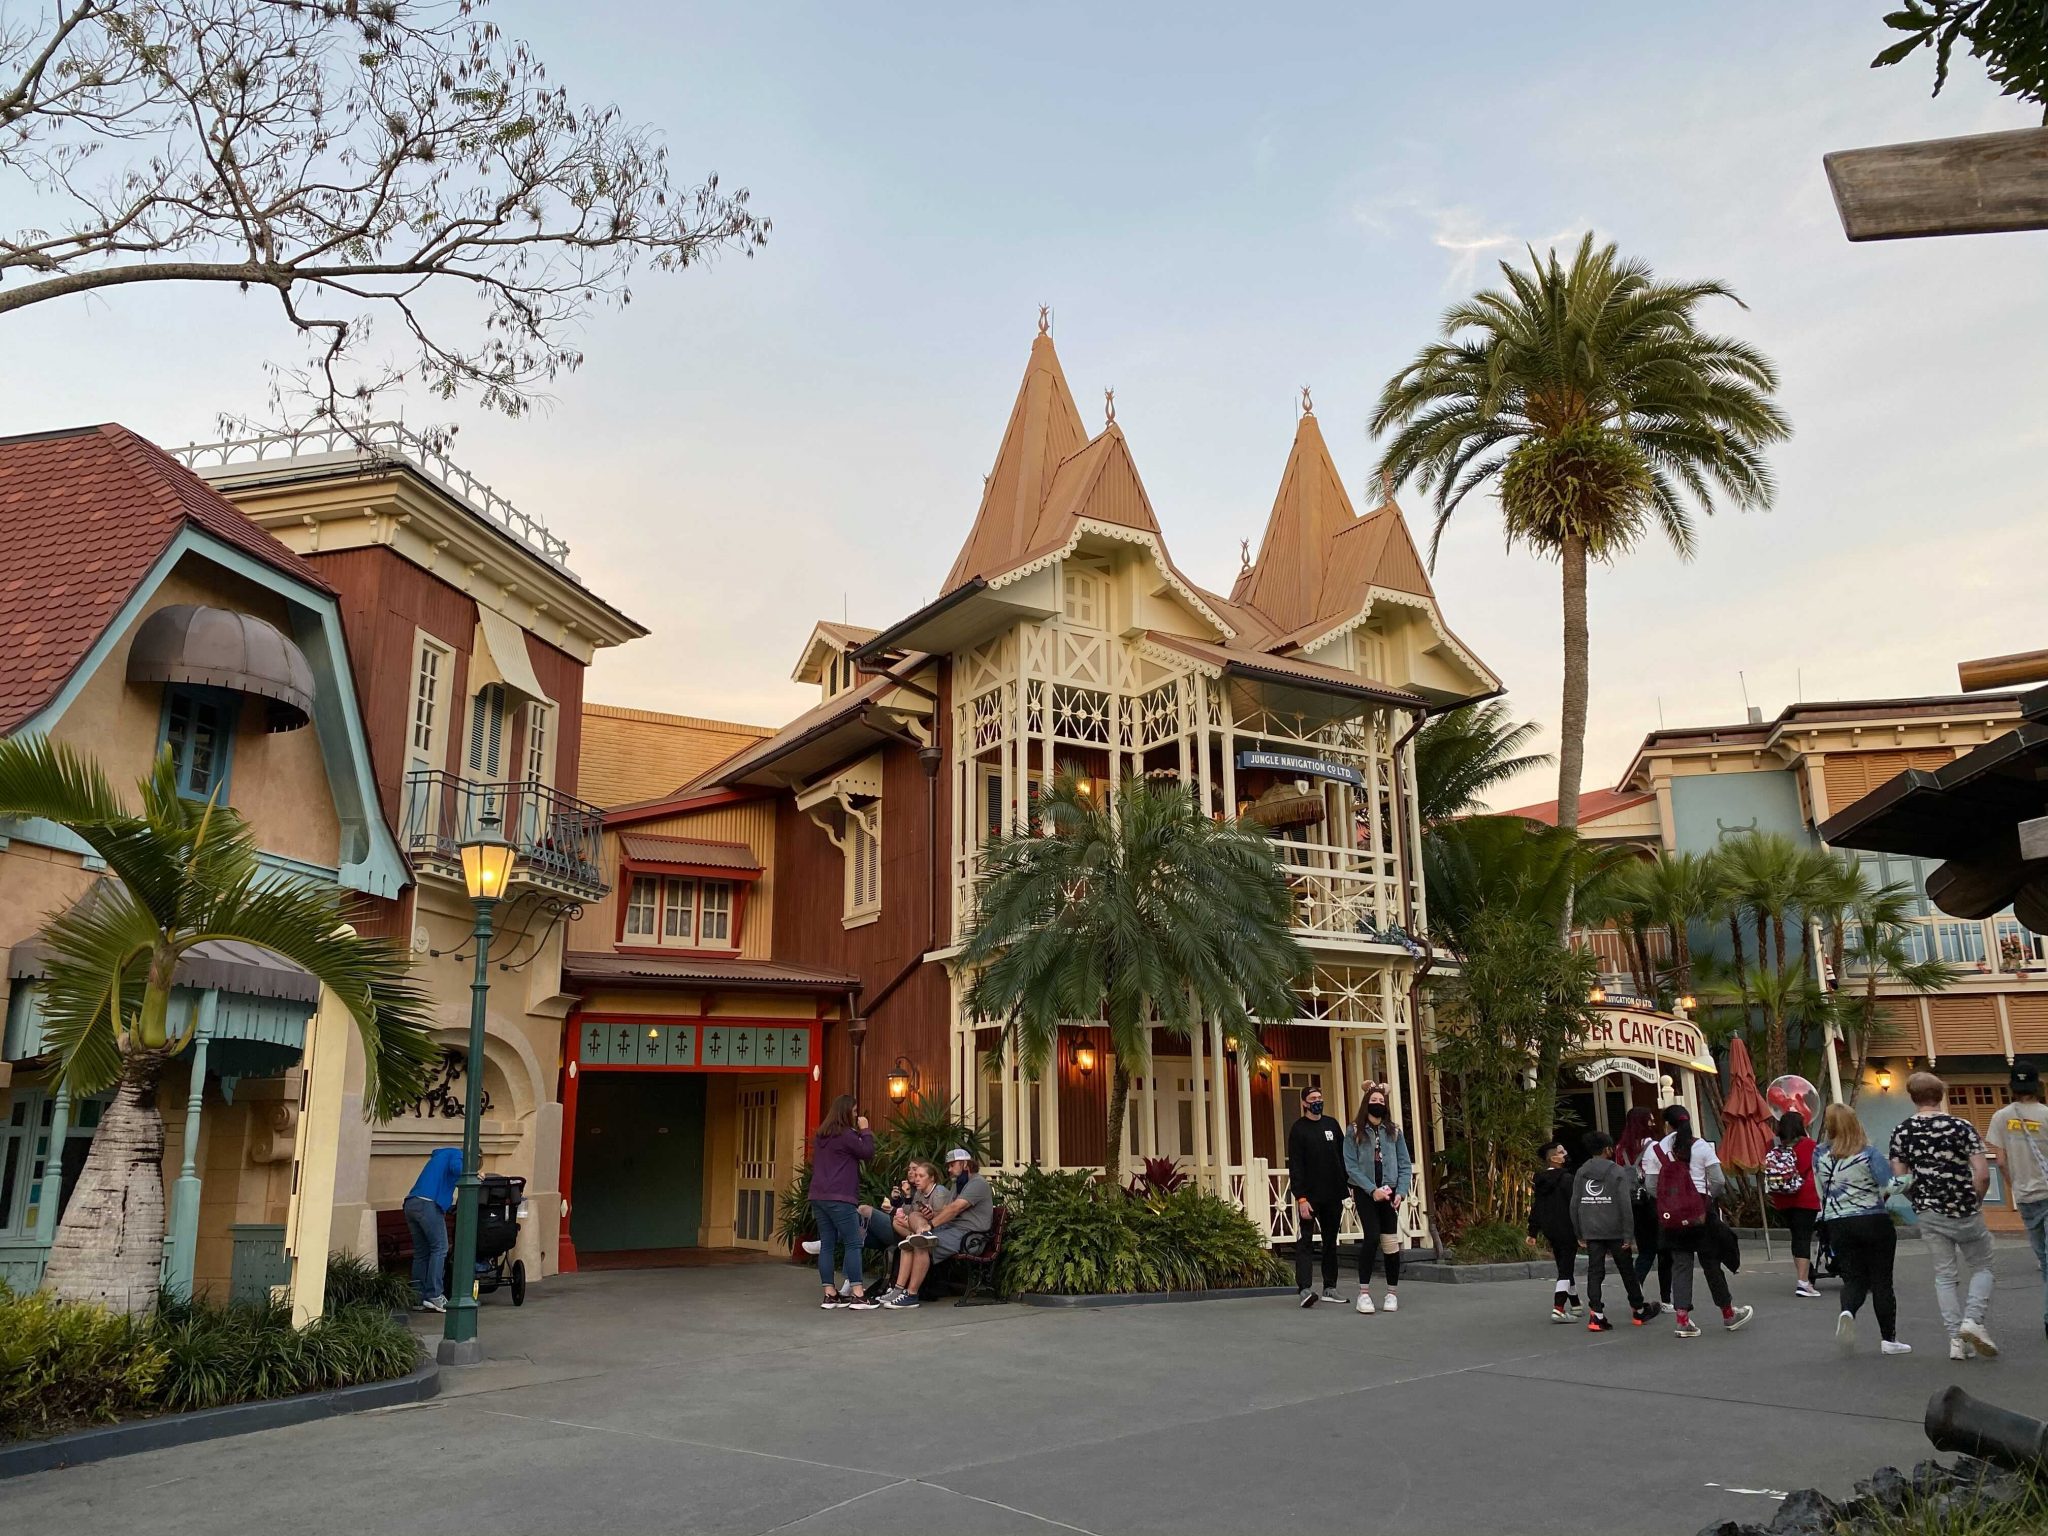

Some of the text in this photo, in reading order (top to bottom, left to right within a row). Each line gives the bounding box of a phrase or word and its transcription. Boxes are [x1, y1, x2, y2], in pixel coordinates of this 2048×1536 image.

[1250, 755, 1279, 766] JUNGLE
[1281, 757, 1325, 772] NAVIGATION
[1337, 767, 1353, 779] LTD.
[1619, 1017, 1696, 1057] CANTEEN
